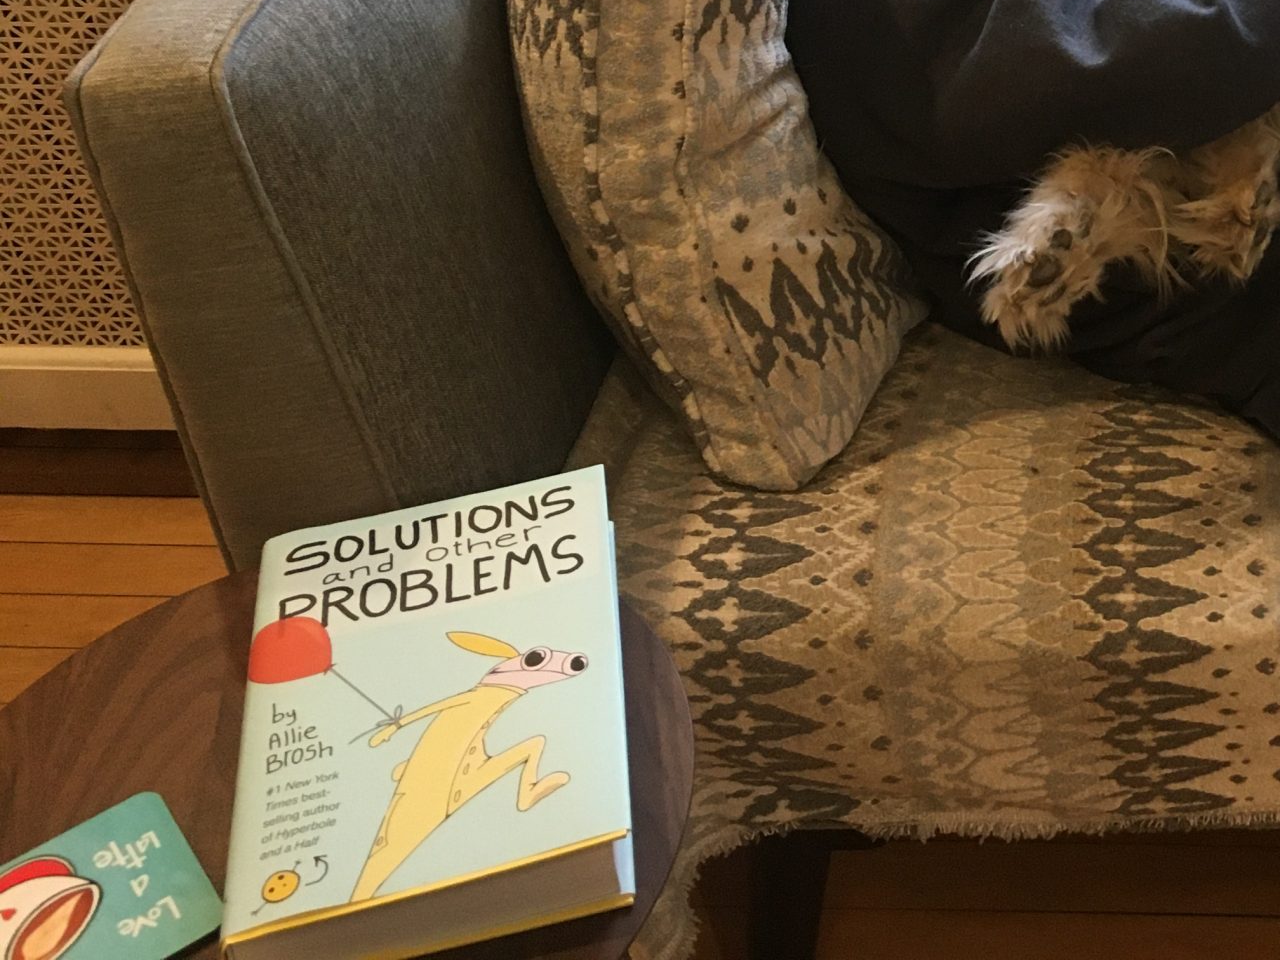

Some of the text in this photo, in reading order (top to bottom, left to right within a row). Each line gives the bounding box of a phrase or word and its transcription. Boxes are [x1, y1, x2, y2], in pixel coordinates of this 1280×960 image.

[284, 485, 575, 576] SOLUTIONS
[322, 525, 542, 584] and other
[278, 534, 584, 630] PROBLEMS
[272, 703, 297, 726] by
[269, 726, 318, 749] Allie
[266, 741, 333, 774] Brosh
[285, 779, 312, 791] New
[315, 771, 339, 783] York
[263, 802, 341, 829] selling author
[266, 797, 298, 812] Times
[261, 818, 337, 844] of Hyperbole
[259, 845, 282, 860] and
[294, 836, 320, 850] Half
[117, 896, 181, 937] Love
